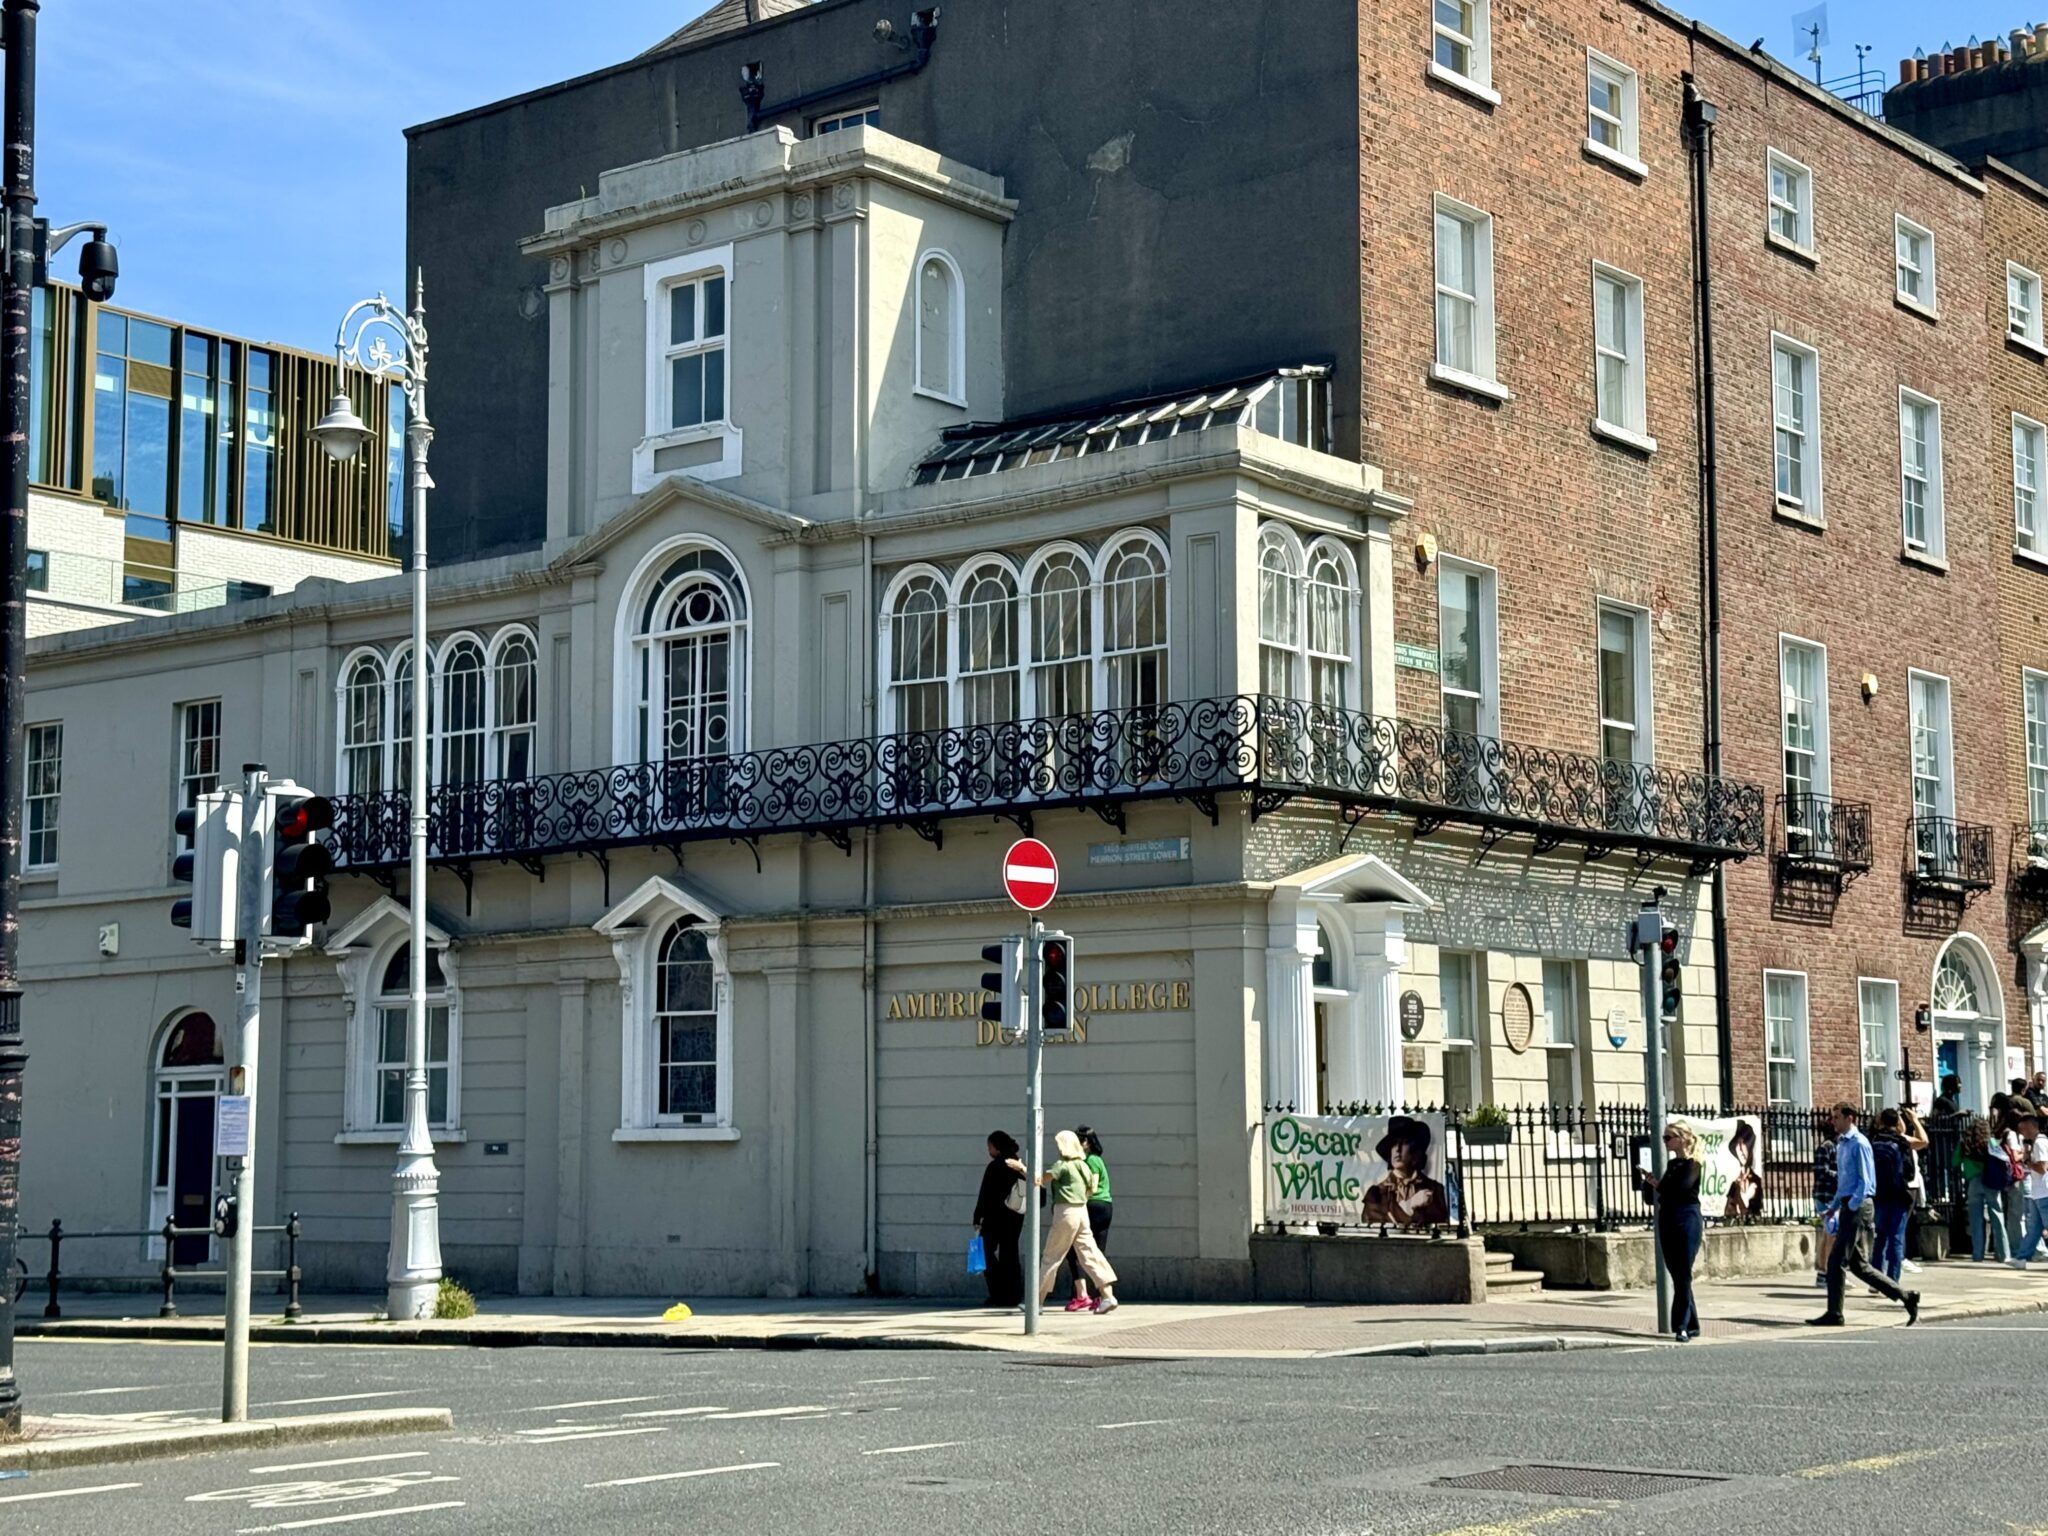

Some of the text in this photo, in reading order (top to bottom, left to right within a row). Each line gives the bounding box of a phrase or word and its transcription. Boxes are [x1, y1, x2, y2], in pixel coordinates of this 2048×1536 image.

[1124, 852, 1150, 862] STREET
[1153, 850, 1178, 861] LOWER
[1074, 982, 1190, 1012] OLLEGE
[1270, 1116, 1362, 1159] Oscar
[1272, 1160, 1360, 1202] Wilde
[1701, 1160, 1727, 1196] lde
[1291, 1204, 1319, 1213] HOUSE
